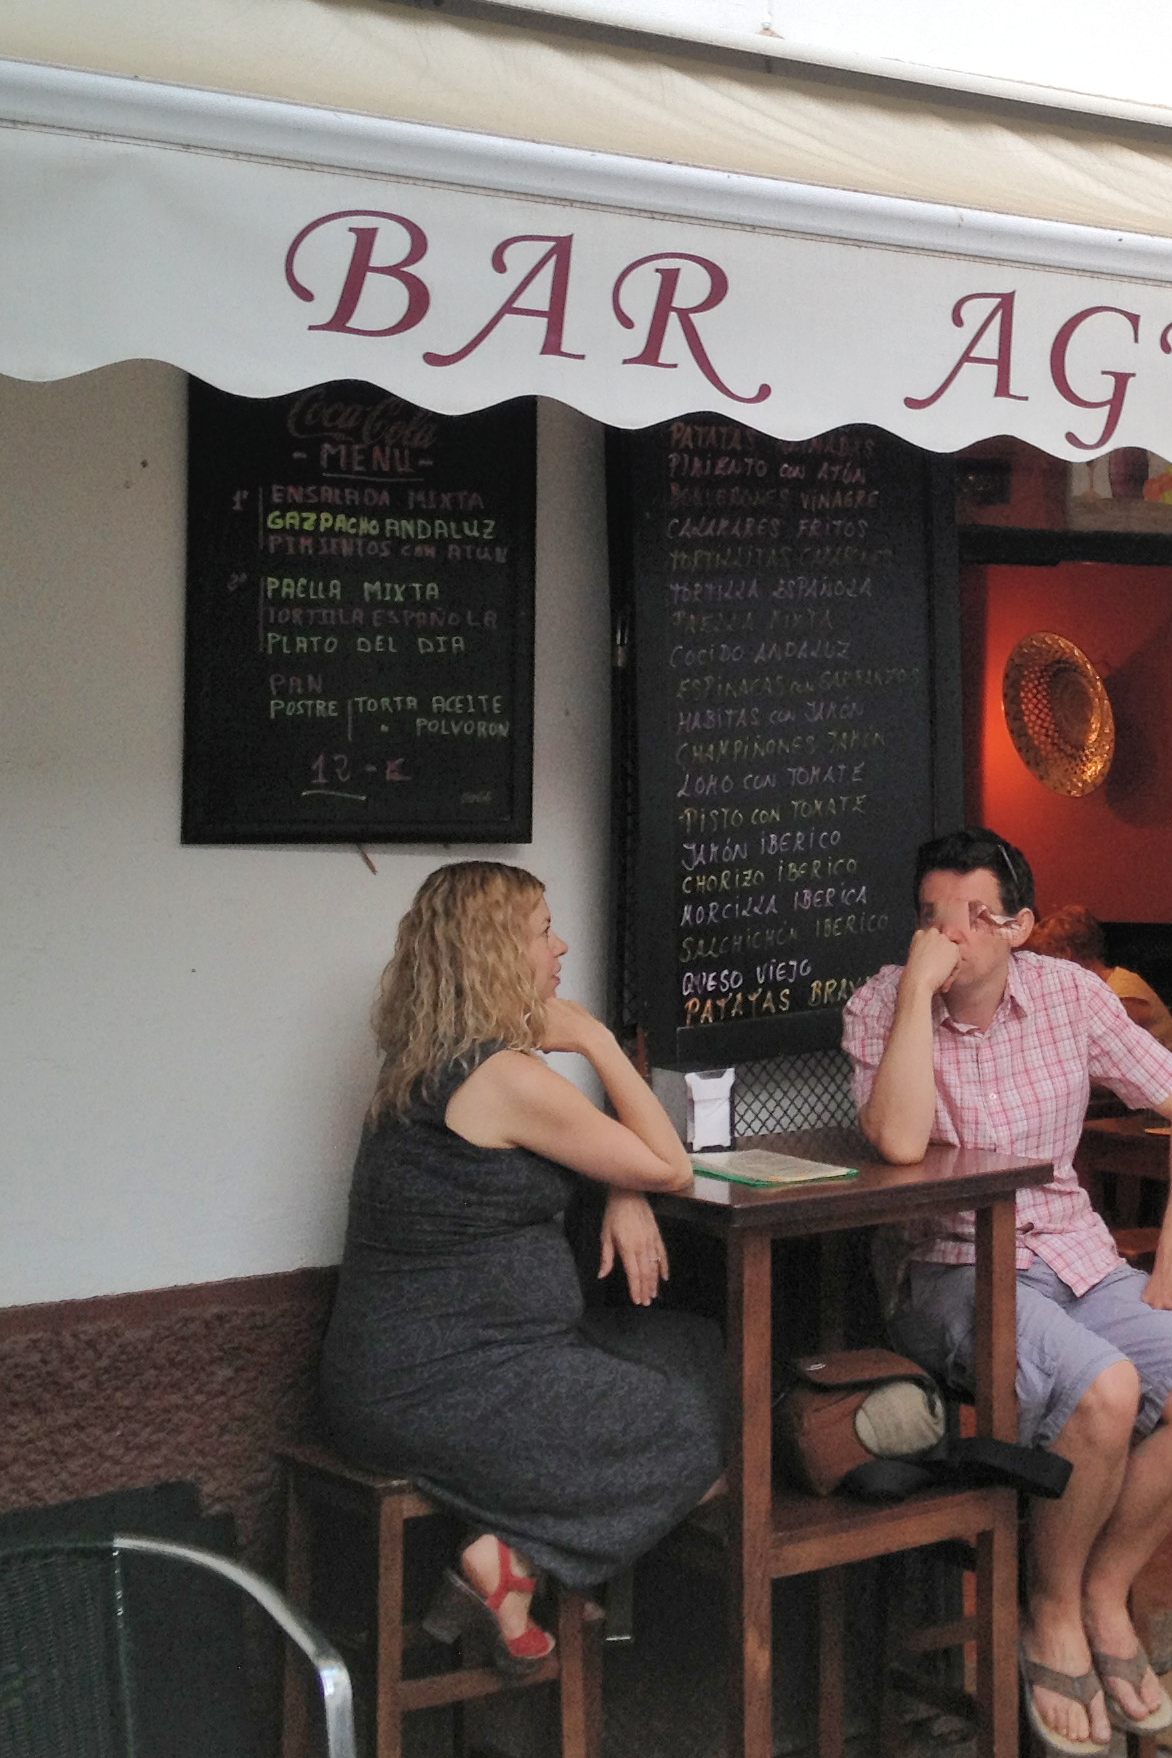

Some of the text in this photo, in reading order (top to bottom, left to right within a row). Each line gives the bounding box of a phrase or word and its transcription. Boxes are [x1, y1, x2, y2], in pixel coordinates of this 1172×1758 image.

[285, 208, 771, 404] BAR
[319, 443, 414, 473] MENU
[272, 484, 390, 507] ENSALADA
[267, 510, 497, 540] GAZPACHO ANDALUZ
[796, 518, 869, 539] FRITOS
[266, 576, 440, 602] PAELLA MIXTA
[267, 632, 466, 654] PLATO DEL DIA
[669, 639, 851, 668] COCIDO ANDALUZ
[269, 673, 323, 695] PAN
[270, 694, 504, 719] POSTRE TORTA ACEITE
[676, 706, 760, 736] HABITAS
[676, 772, 734, 799] LOMO
[787, 761, 866, 788] TOMATE
[678, 794, 868, 835] PISTO CON TOMATE
[682, 868, 765, 895] CHORIZO
[679, 895, 779, 928] MORCILLA
[682, 958, 813, 996] QUESO VIEJO
[684, 987, 791, 1027] PATATAS
